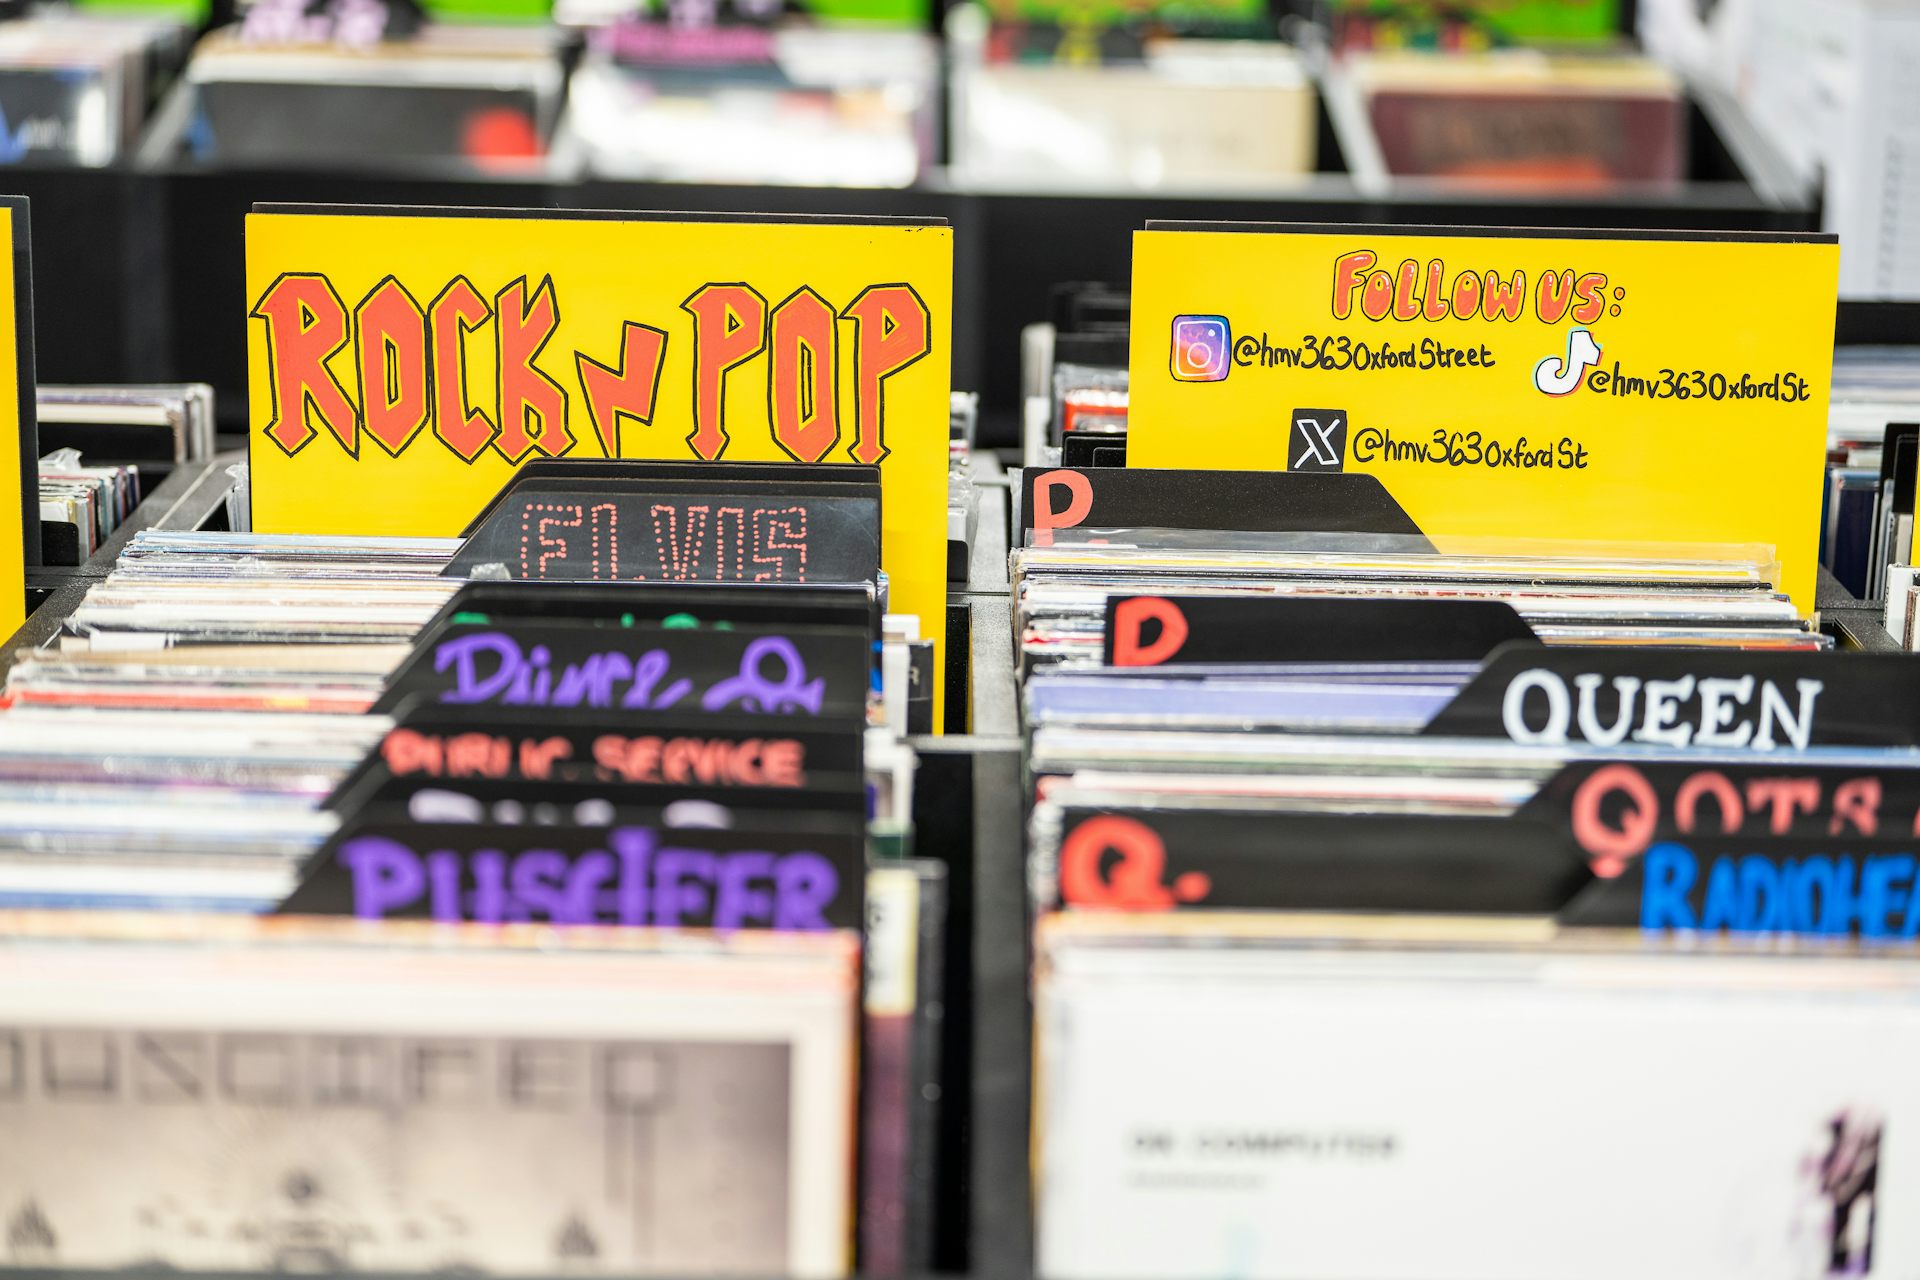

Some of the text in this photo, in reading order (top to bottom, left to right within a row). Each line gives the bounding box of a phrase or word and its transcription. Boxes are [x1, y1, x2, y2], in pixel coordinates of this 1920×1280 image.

[250, 272, 577, 466] ROCK
[679, 281, 932, 464] POP
[592, 733, 806, 788] SERVICE
[1502, 667, 1825, 751] QUEEN
[1571, 762, 1920, 879] QOTS
[336, 826, 840, 931] PUSCIFER
[1640, 840, 1920, 941] RADIOHE
